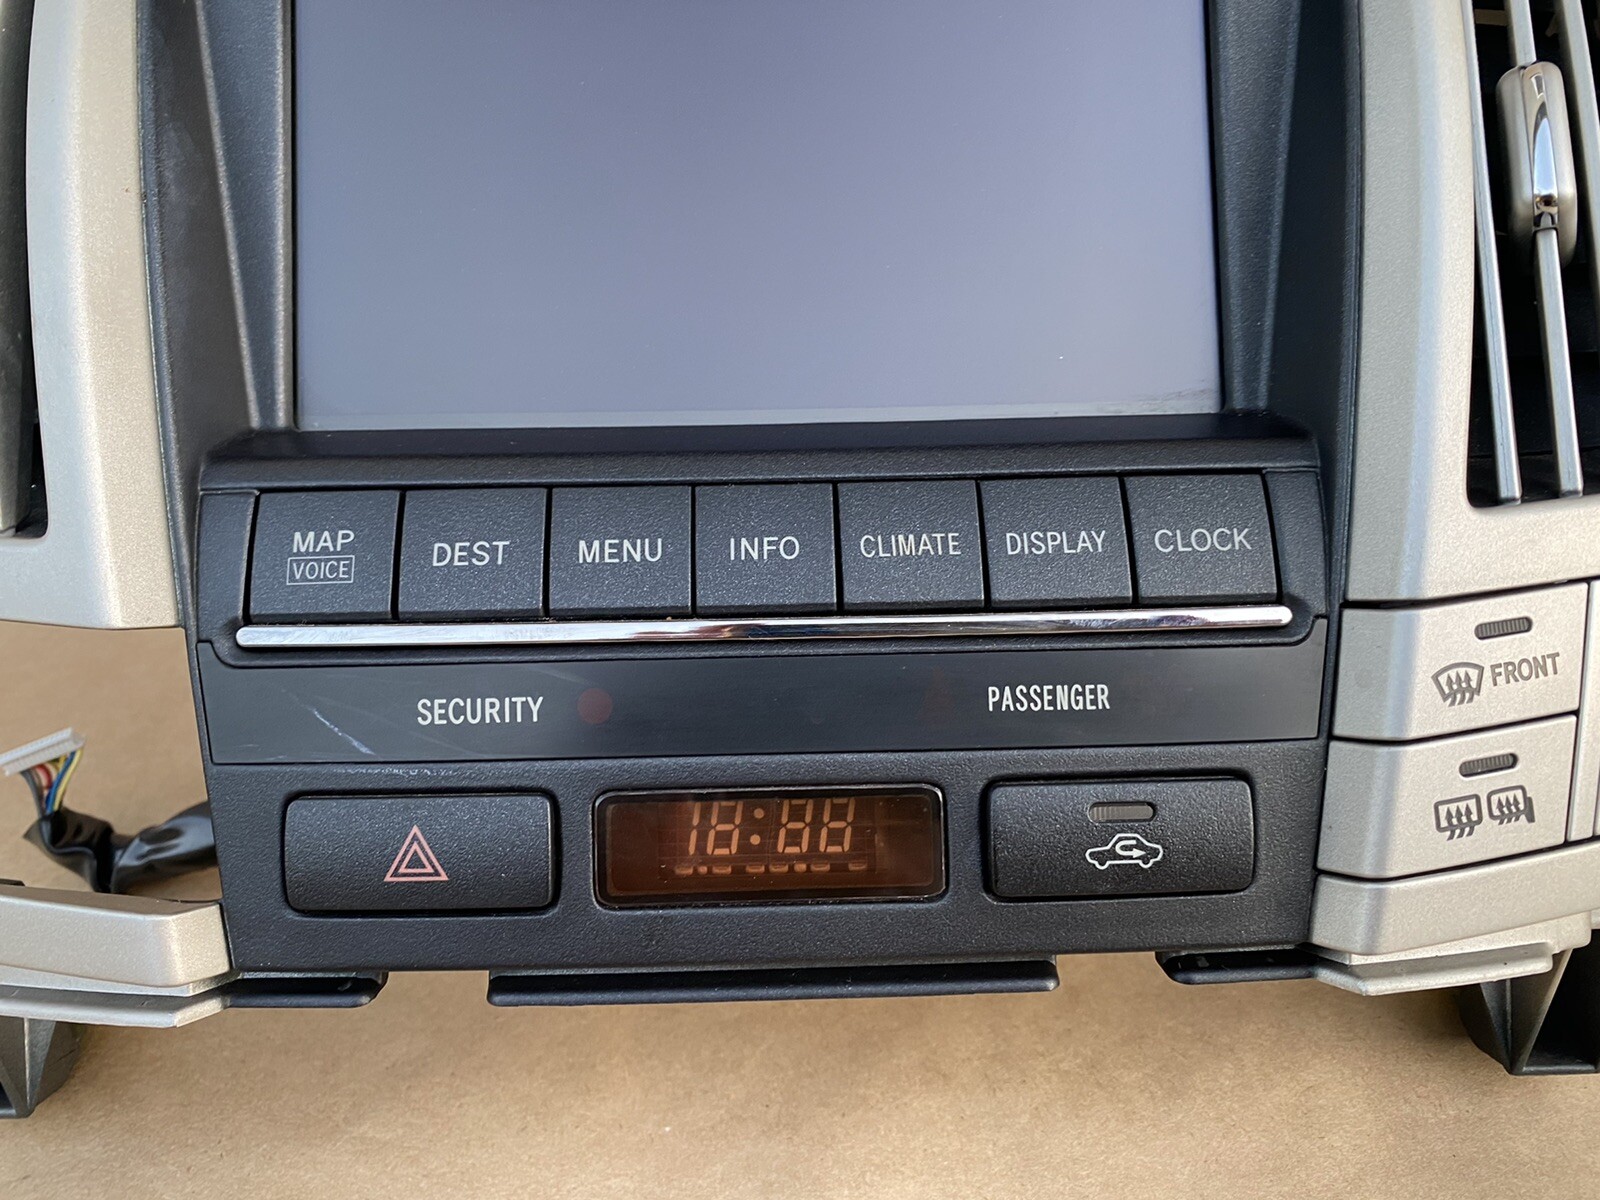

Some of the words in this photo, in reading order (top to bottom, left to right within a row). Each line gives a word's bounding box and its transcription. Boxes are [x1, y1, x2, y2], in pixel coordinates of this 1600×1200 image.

[293, 530, 355, 553] MAP
[578, 538, 663, 563] MENU
[729, 535, 801, 561] INFO
[859, 532, 962, 559] CLIMATE
[1005, 530, 1106, 556] DISPLAY
[1153, 527, 1252, 553] CLOCK
[432, 541, 510, 567] DEST
[293, 561, 350, 580] VOICE
[1490, 652, 1560, 687] FRONT
[416, 696, 544, 726] SECURITY
[988, 684, 1110, 712] PASSENGER
